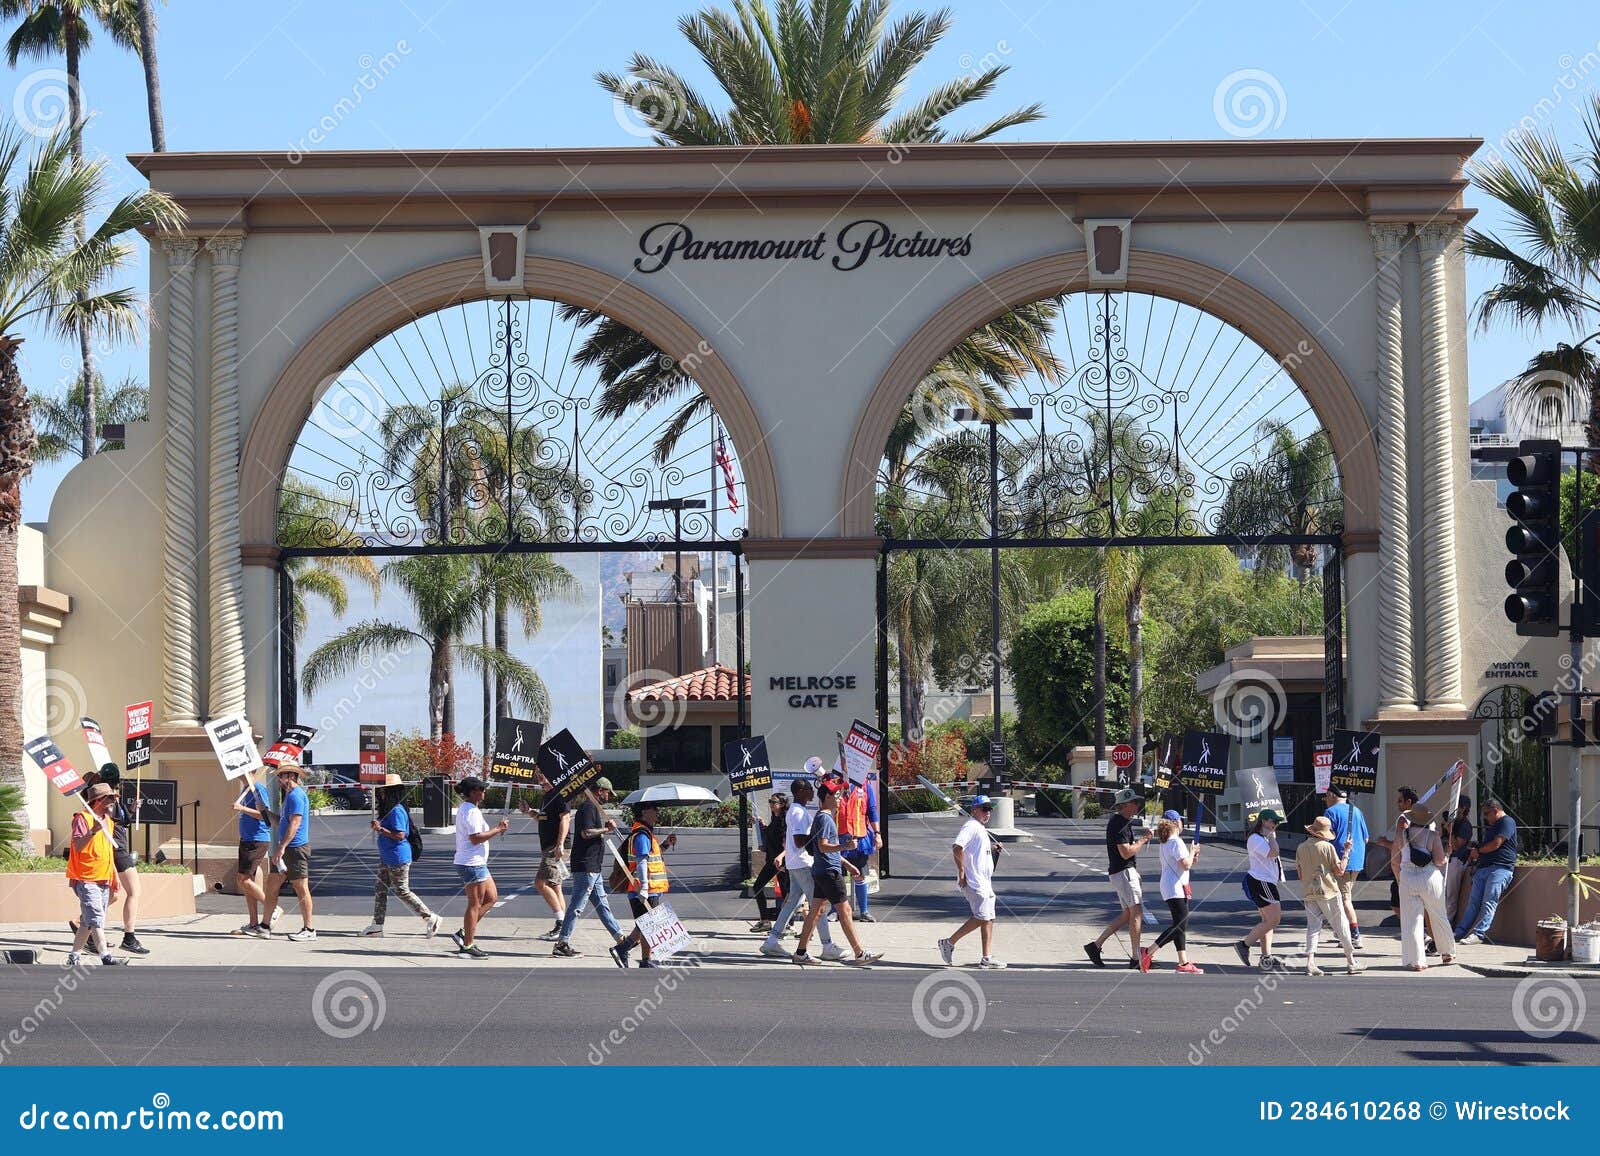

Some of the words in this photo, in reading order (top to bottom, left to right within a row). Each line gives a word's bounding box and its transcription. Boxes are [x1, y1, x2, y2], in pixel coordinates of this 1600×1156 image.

[633, 222, 825, 274] Paramount
[832, 219, 973, 272] Pictures
[1492, 662, 1530, 670] VISITOR
[1485, 670, 1538, 679] ENTRANCE
[769, 675, 856, 691] MELROSE
[788, 695, 838, 709] GATE
[847, 733, 876, 757] STRIKE!
[1113, 752, 1133, 761] STOP
[361, 763, 385, 775] STRIKE!
[493, 764, 534, 778] STRIKE!
[560, 767, 597, 798] STRIKE!
[732, 775, 771, 791] STRIKE!
[1181, 777, 1225, 789] STRIKE!
[1332, 776, 1374, 788] STRIKE!
[127, 797, 145, 805] ET
[146, 798, 168, 806] ONLY
[650, 921, 683, 949] LIGHT
